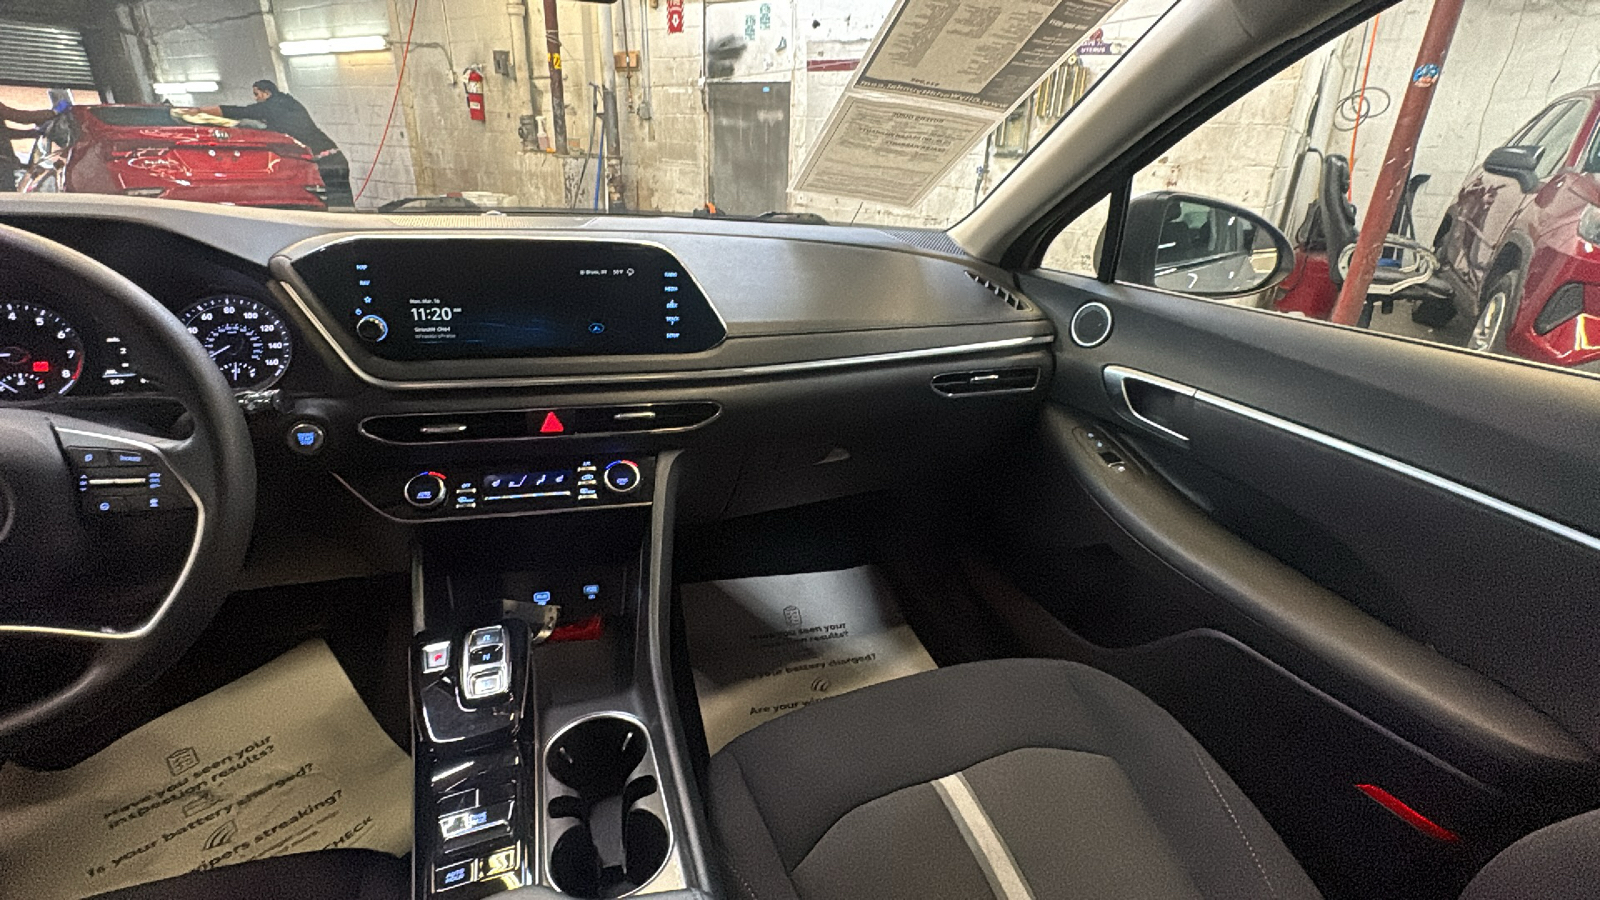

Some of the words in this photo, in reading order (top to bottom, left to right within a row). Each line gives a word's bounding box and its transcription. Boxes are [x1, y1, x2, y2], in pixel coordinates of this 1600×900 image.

[223, 306, 236, 314] 80
[410, 307, 453, 321] 11:20
[8, 312, 17, 321] 4
[201, 312, 213, 321] 60
[243, 312, 259, 320] 100
[35, 317, 45, 326] 5
[260, 324, 275, 332] 120
[57, 330, 66, 339] 6
[66, 349, 76, 359] 7
[265, 358, 279, 366] 160
[61, 369, 71, 379] 8
[749, 706, 770, 715] Are
[772, 701, 799, 713] your
[155, 777, 189, 799] you
[193, 755, 233, 778] seen
[234, 735, 272, 760] your
[254, 788, 343, 845] streaking?
[111, 840, 158, 868] your
